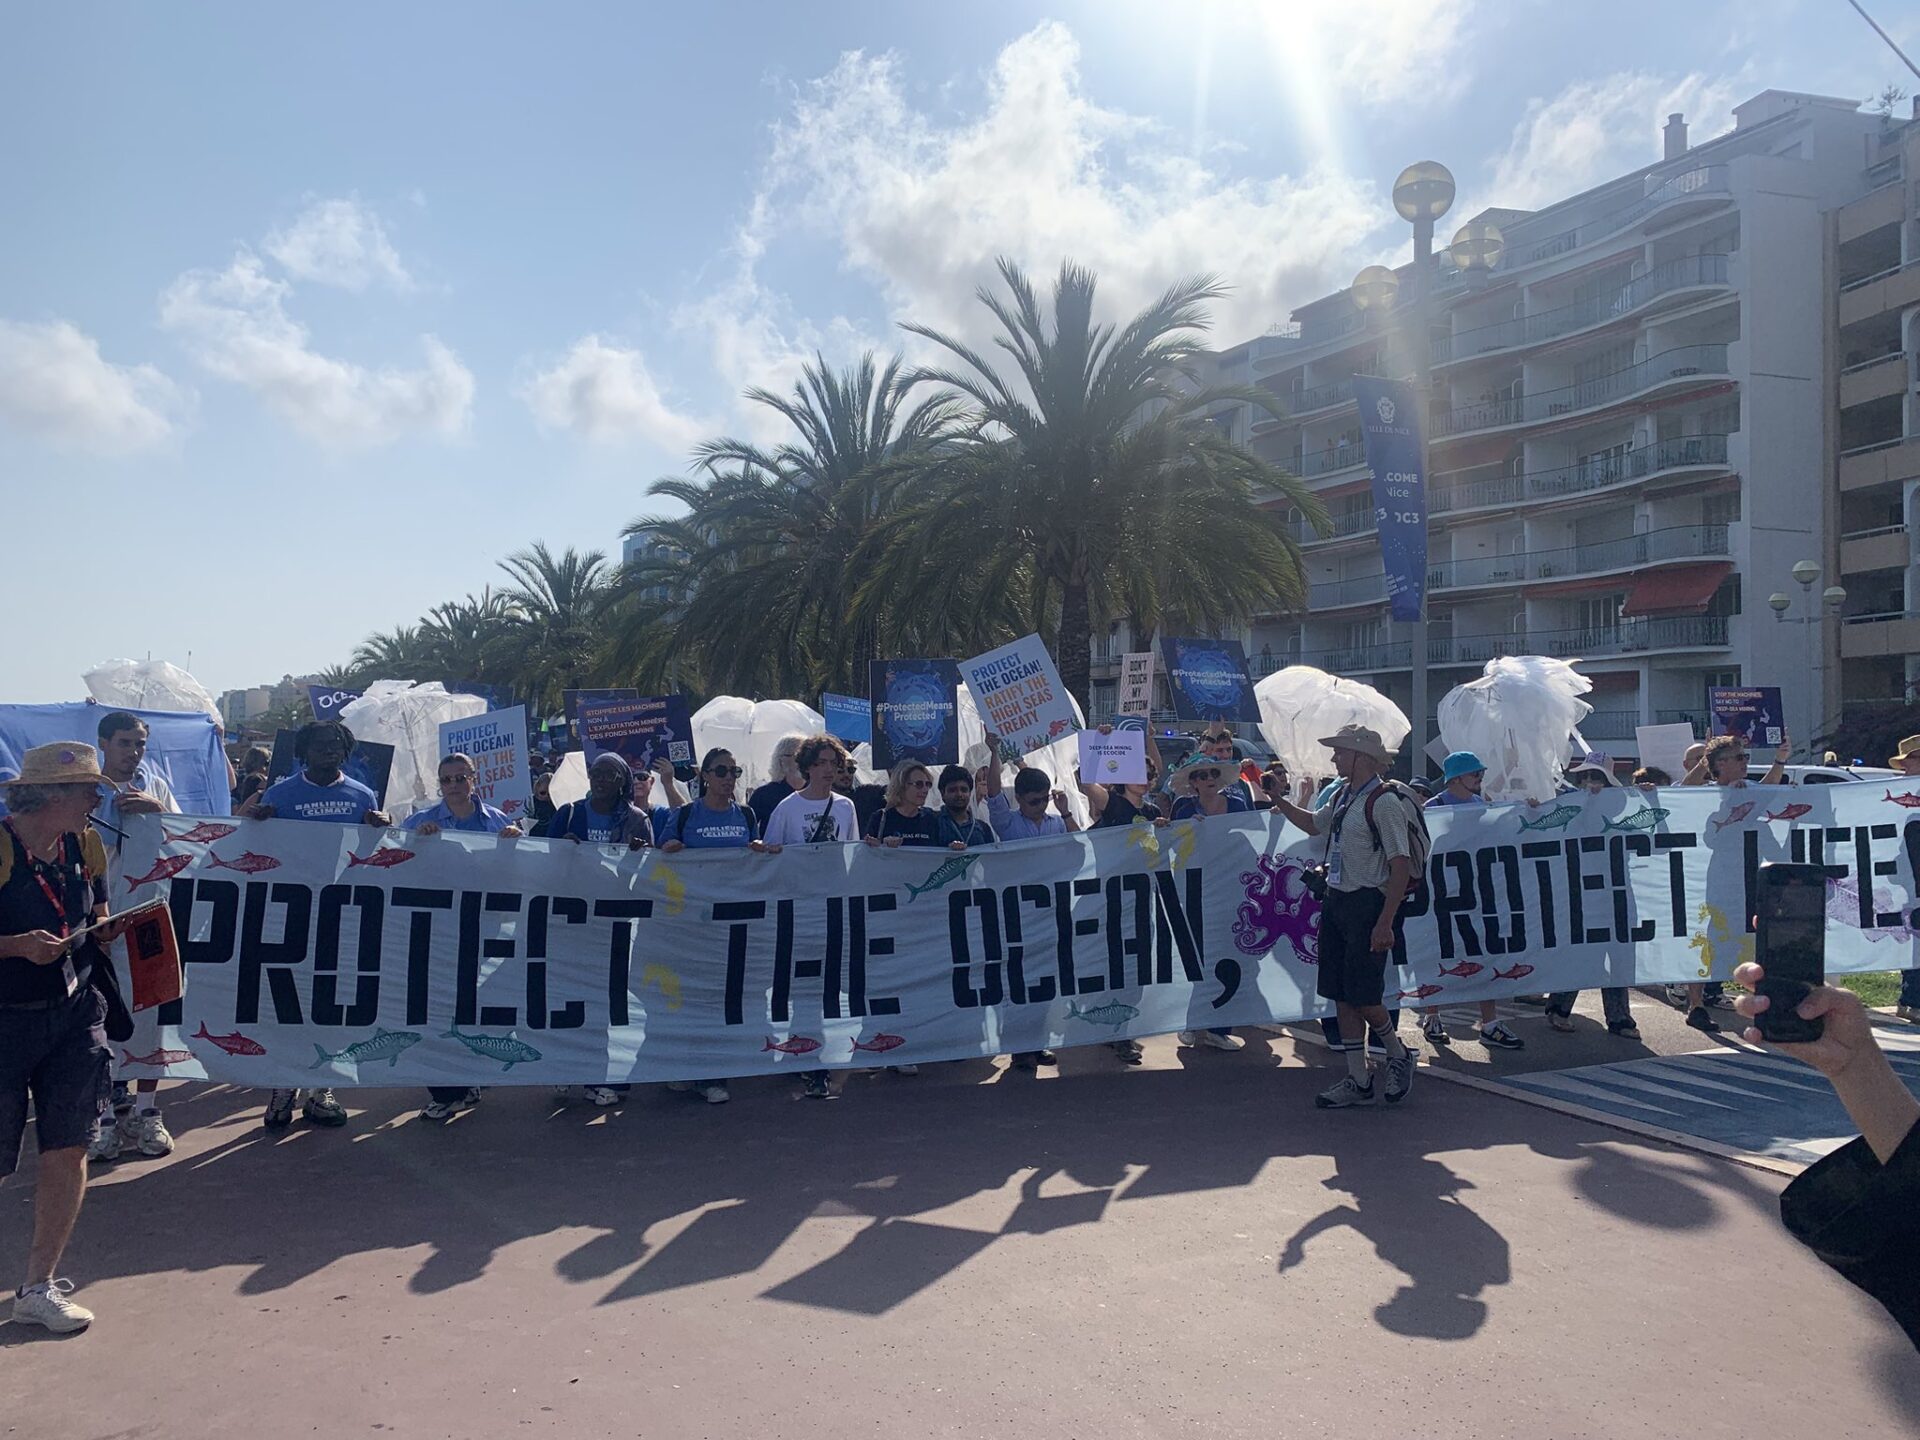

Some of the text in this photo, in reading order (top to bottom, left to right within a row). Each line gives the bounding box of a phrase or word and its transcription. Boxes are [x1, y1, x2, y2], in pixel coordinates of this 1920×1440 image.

[1384, 472, 1418, 484] COME
[970, 652, 1022, 682] PROTECT
[1172, 669, 1246, 680] #ProtectedMeans
[976, 659, 1043, 695] THE OCEAN!
[1128, 673, 1148, 685] TOUCH
[1190, 677, 1232, 687] Protected
[984, 673, 1050, 710] RATIFY THE
[1132, 687, 1142, 698] MY
[586, 701, 667, 718] STOPPEZ LES MACHINES
[876, 701, 953, 713] #ProtectedMeans
[990, 688, 1054, 724] HIGH SEAS
[1123, 699, 1148, 712] BOTTOM
[894, 710, 937, 722] Protected
[995, 709, 1040, 737] TREATY
[447, 722, 498, 745] PROTECT
[604, 729, 628, 738] FONDS
[628, 726, 655, 735] MARINS
[473, 732, 514, 754] OCEAN!
[492, 748, 516, 766] THE
[485, 764, 515, 783] SEAS
[295, 800, 358, 811] BANLIEUES
[157, 876, 653, 1031] PROTECT
[711, 892, 902, 1026] THE
[946, 867, 1242, 1010] OCEAN,
